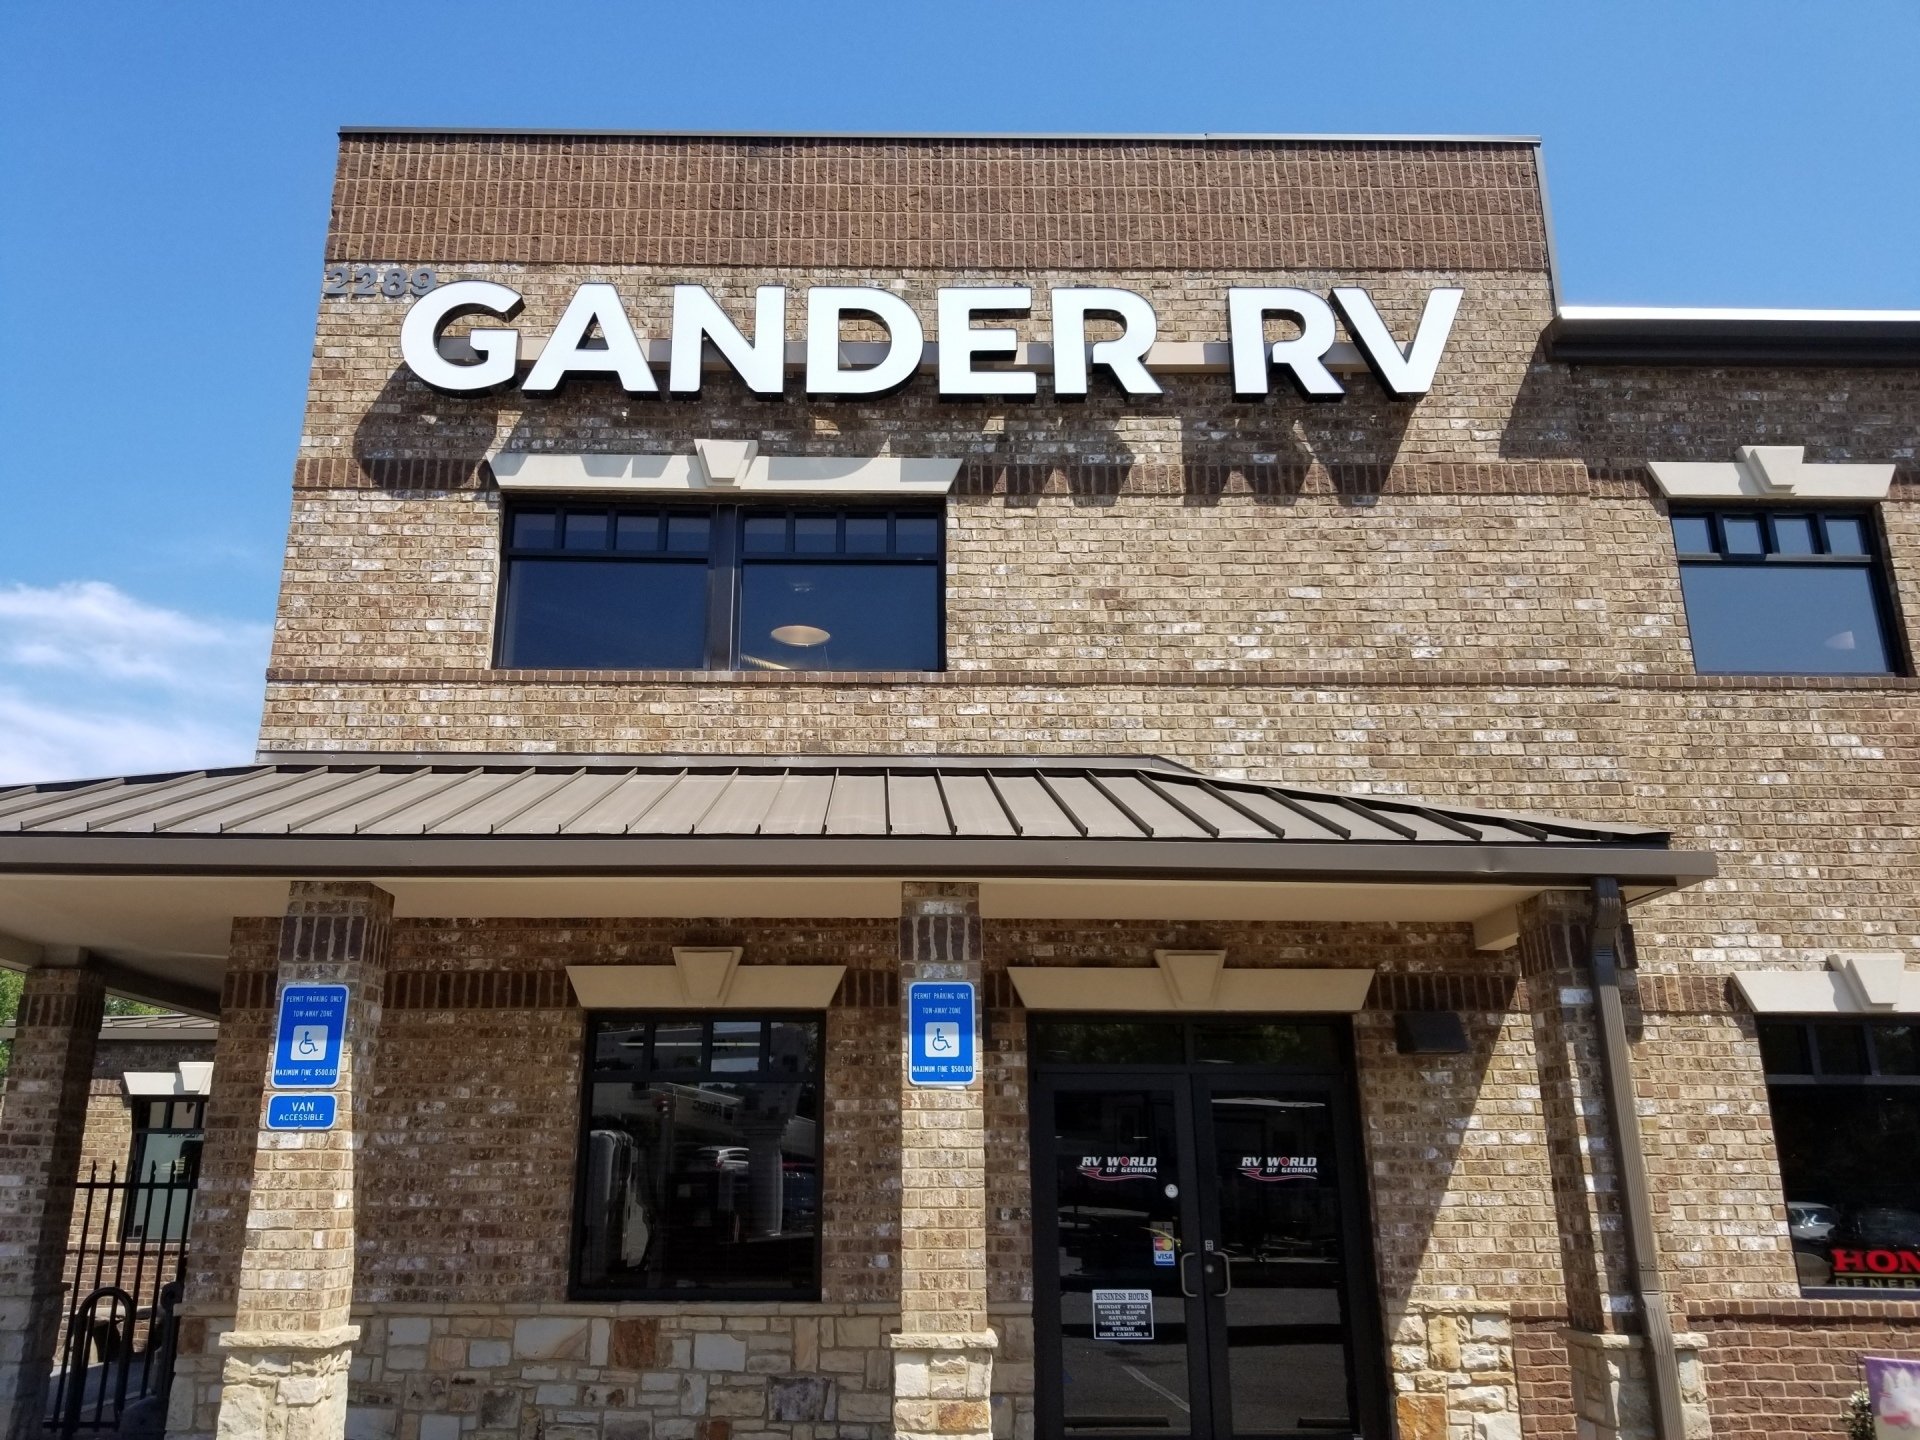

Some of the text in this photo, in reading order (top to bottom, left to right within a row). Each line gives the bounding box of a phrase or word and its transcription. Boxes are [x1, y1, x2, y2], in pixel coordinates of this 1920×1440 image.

[325, 266, 438, 297] 2289
[400, 280, 1464, 399] GANDER RV
[286, 995, 343, 1003] PERMIT PARKING ONLY
[913, 992, 969, 1000] PERMIT PARKING ONLY
[319, 1010, 333, 1018] ZONE
[275, 1068, 337, 1076] MAXIMUM FINE $500.00
[912, 1065, 973, 1073] MAXIMUM FINE $500.00
[292, 1101, 315, 1112] VAN
[278, 1113, 325, 1121] ACCESSIBLE
[1081, 1156, 1158, 1167] RV WORLD
[1241, 1156, 1318, 1167] RV WORLD
[1095, 1292, 1149, 1300] BUSINESS HOURS
